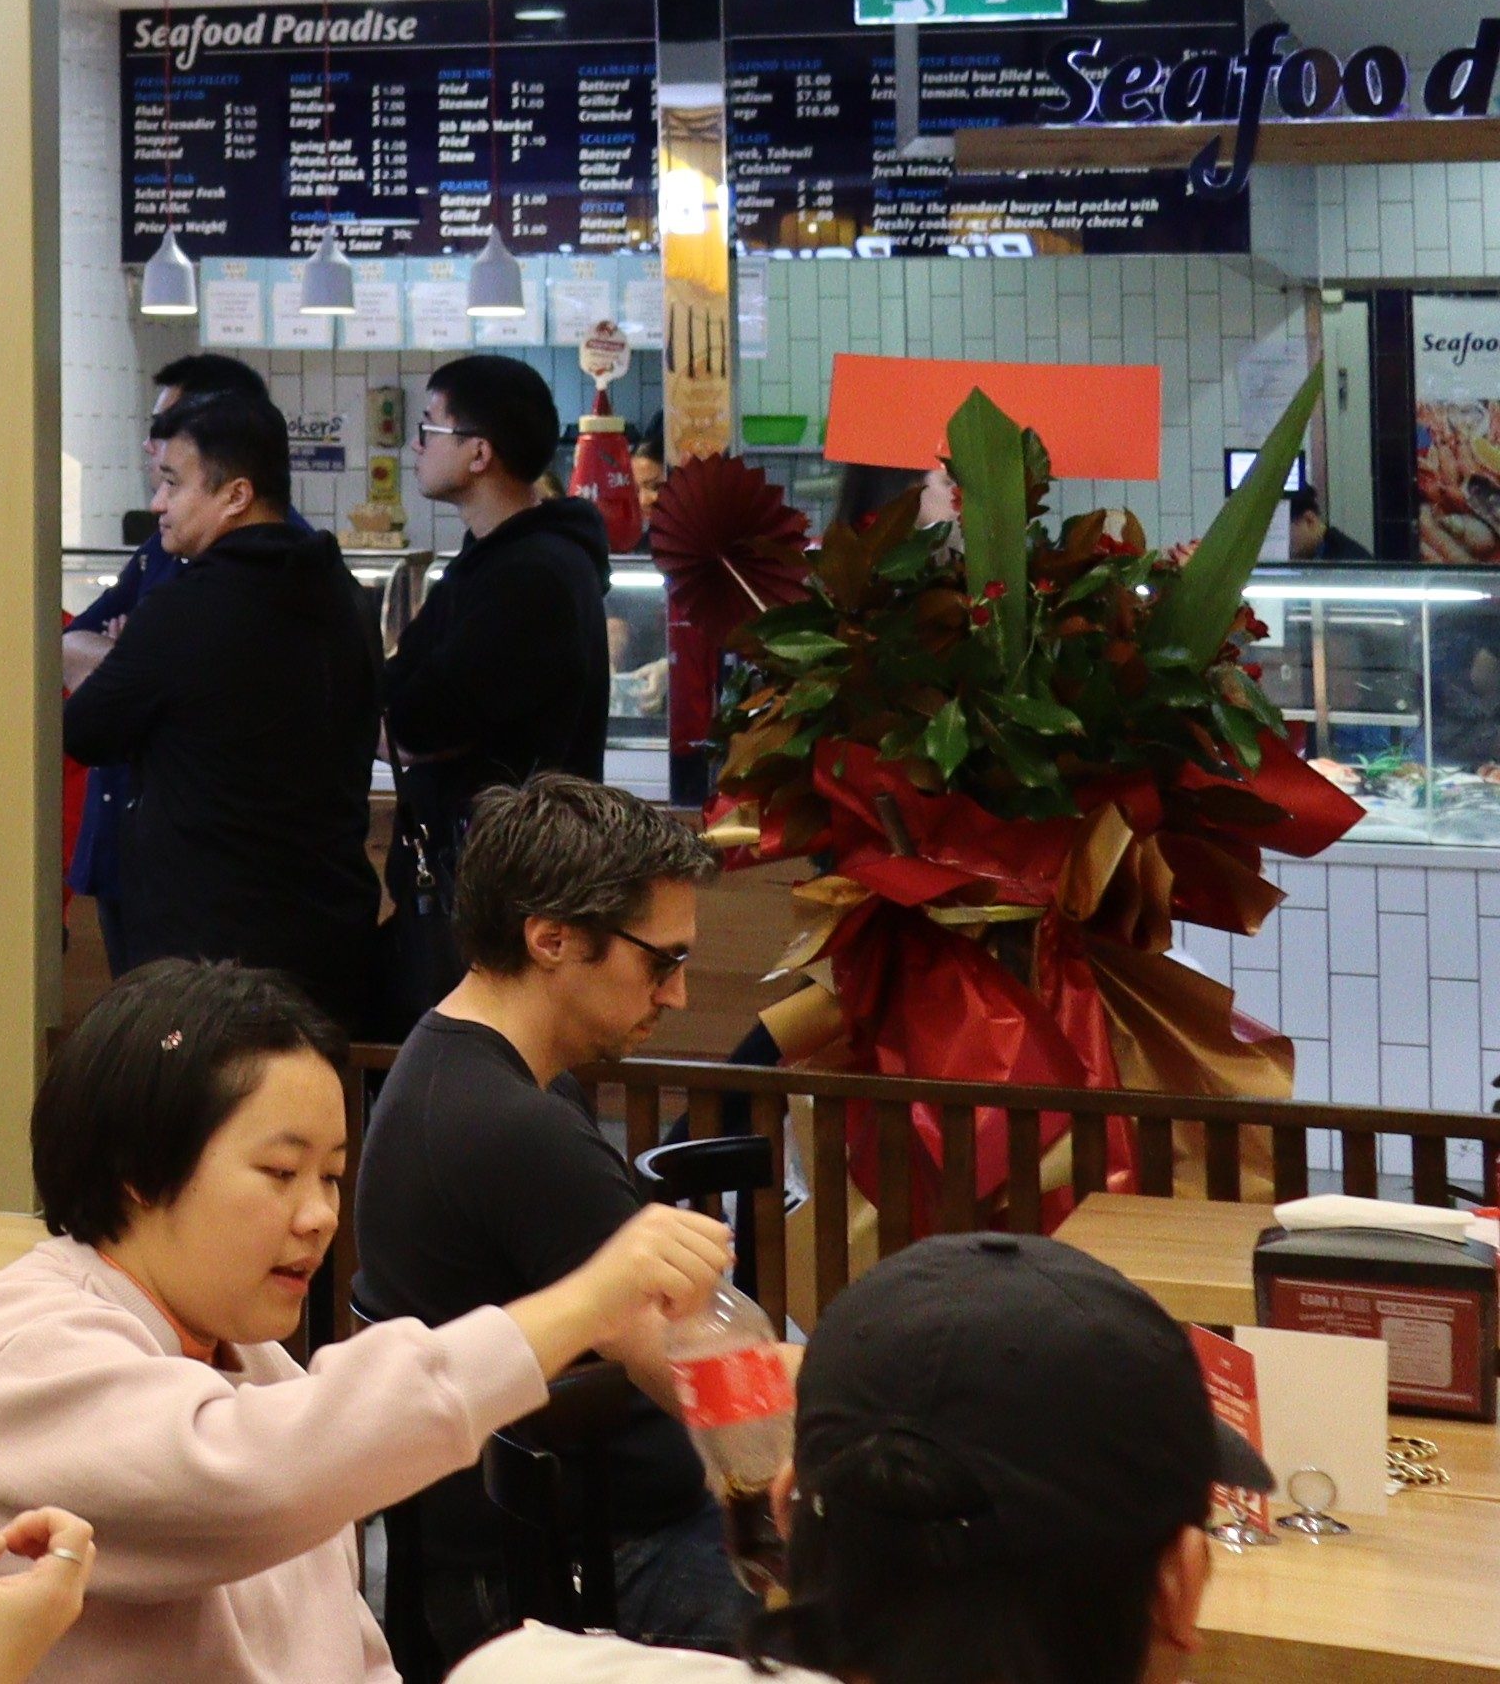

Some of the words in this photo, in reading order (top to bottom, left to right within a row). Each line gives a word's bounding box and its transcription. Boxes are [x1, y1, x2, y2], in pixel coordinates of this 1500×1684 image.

[134, 10, 266, 71] Seafood
[271, 9, 418, 45] Paradise
[922, 70, 969, 84] toasted
[971, 70, 995, 83] bun
[998, 68, 1033, 83] filled
[290, 86, 322, 99] Small
[438, 82, 469, 95] Fried
[578, 79, 630, 93] Battered
[972, 86, 1015, 99] cheese
[438, 96, 489, 110] Steamed
[578, 94, 620, 108] Grilled
[579, 108, 633, 122] Crumbed
[1041, 17, 1500, 202] Seafood
[290, 117, 321, 131] Large
[290, 140, 326, 155] Spring
[328, 138, 352, 152] Roll
[438, 134, 470, 148] Fried
[438, 150, 476, 163] Steam
[579, 147, 632, 161] Battered
[579, 162, 620, 177] Grilled
[738, 163, 792, 176] Coleslaw
[290, 184, 313, 196] Fish
[579, 177, 634, 192] Crumbed
[134, 187, 166, 199] Select
[196, 186, 226, 199] Fresh
[439, 193, 491, 207] Battered
[873, 202, 898, 215] Just
[900, 202, 924, 214] like
[926, 201, 947, 214] the
[950, 200, 1008, 214] standard
[1009, 199, 1053, 215] burger
[1055, 198, 1078, 213] but
[1080, 198, 1127, 214] packed
[1129, 199, 1159, 212] with
[134, 202, 157, 214] Fish
[439, 208, 481, 223] Grilled
[872, 216, 915, 231] freshly
[918, 216, 963, 229] cooked
[1086, 215, 1129, 228] cheese
[439, 223, 494, 238] Crumbed
[348, 239, 382, 251] Sauce
